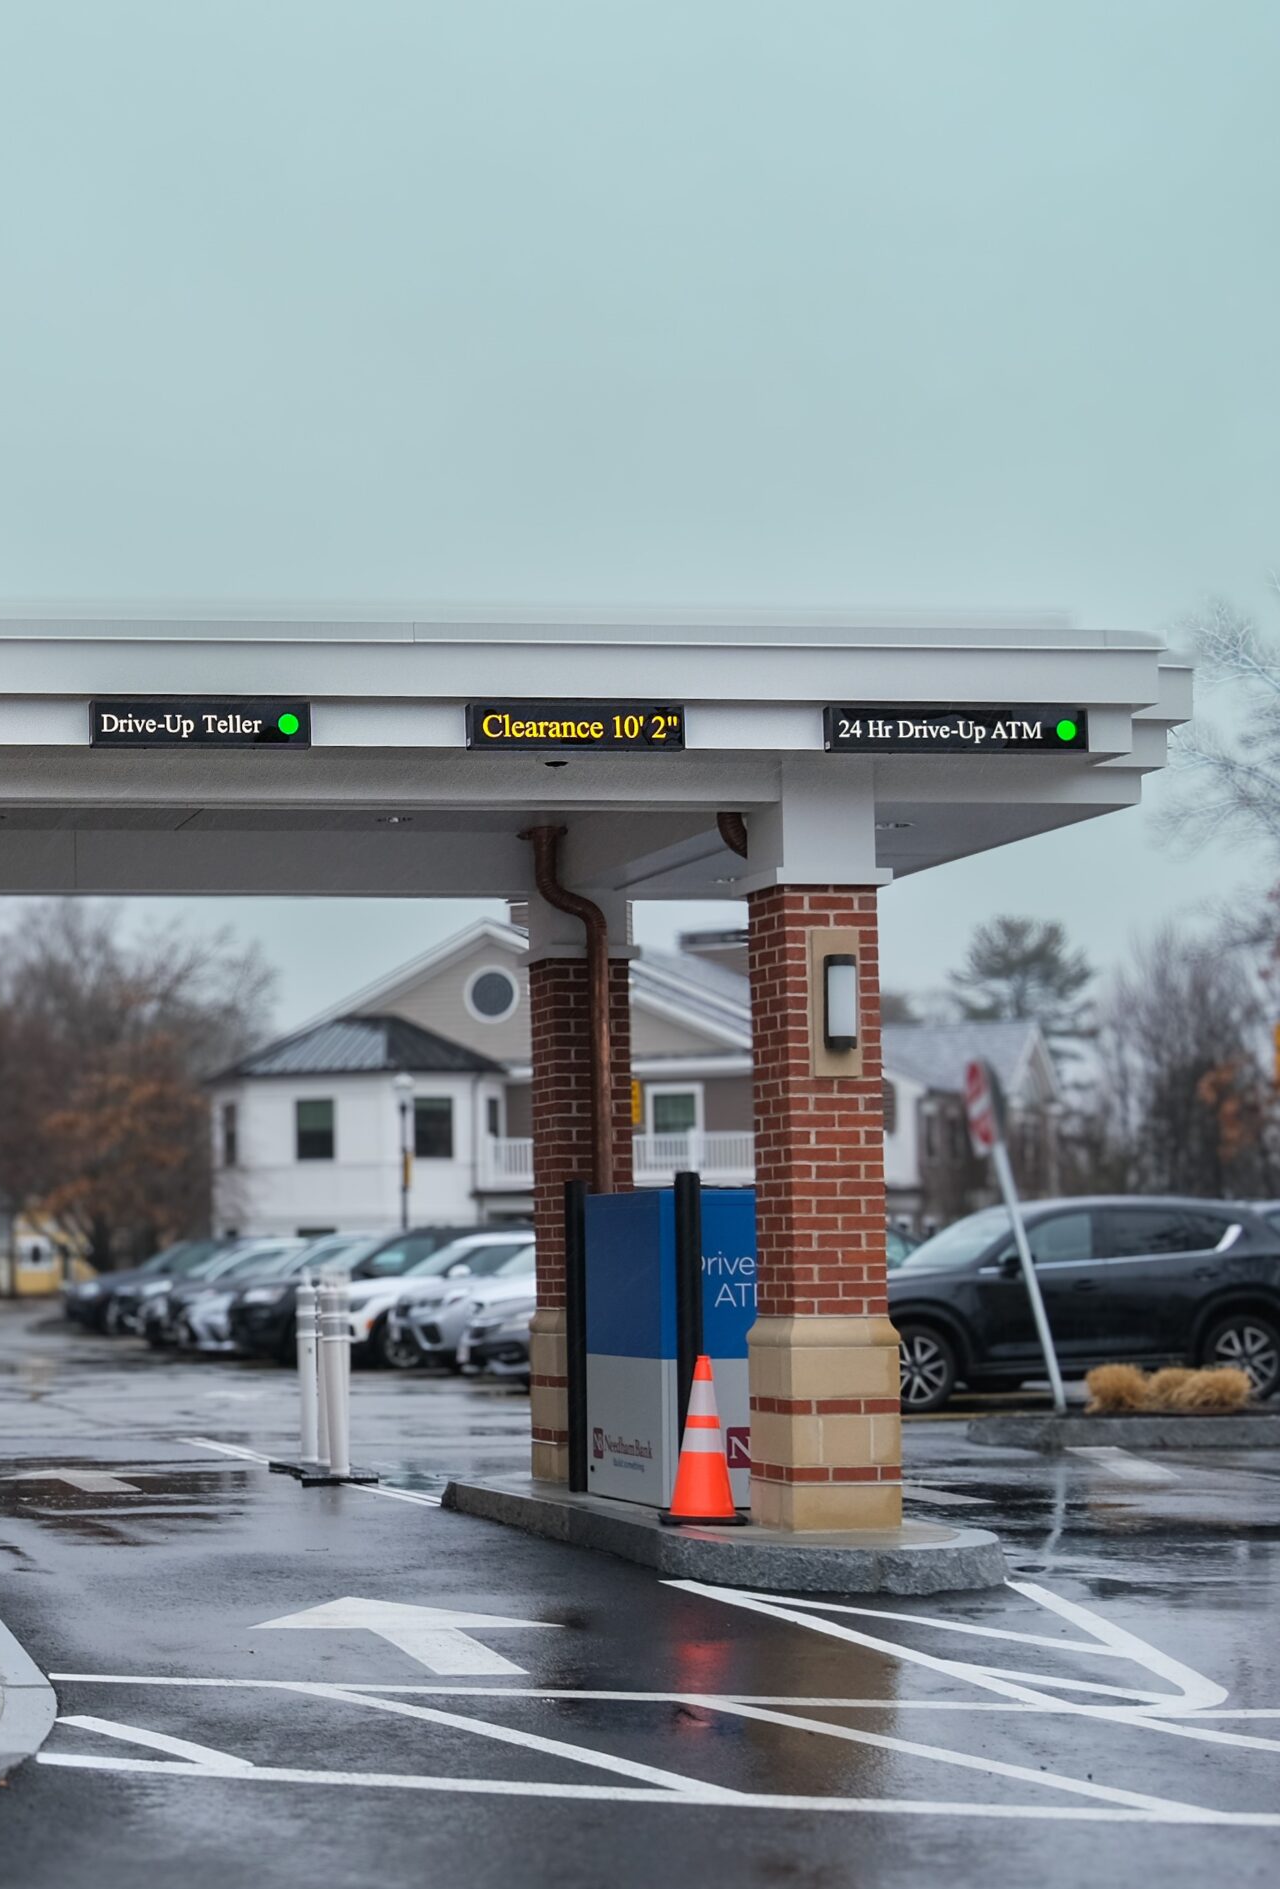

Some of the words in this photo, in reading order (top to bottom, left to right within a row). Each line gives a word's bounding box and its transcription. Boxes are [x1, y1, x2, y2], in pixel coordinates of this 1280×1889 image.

[100, 713, 195, 738] Drive-Up
[202, 714, 263, 734] Teller
[482, 713, 604, 739] Clearance
[612, 715, 644, 739] 10'
[651, 715, 678, 739] 2"
[838, 719, 862, 738] 24
[867, 719, 893, 739] Hr
[897, 719, 987, 744] Drive-Up
[990, 720, 1043, 740] ATM
[701, 1250, 756, 1276] rive
[714, 1283, 758, 1307] AT
